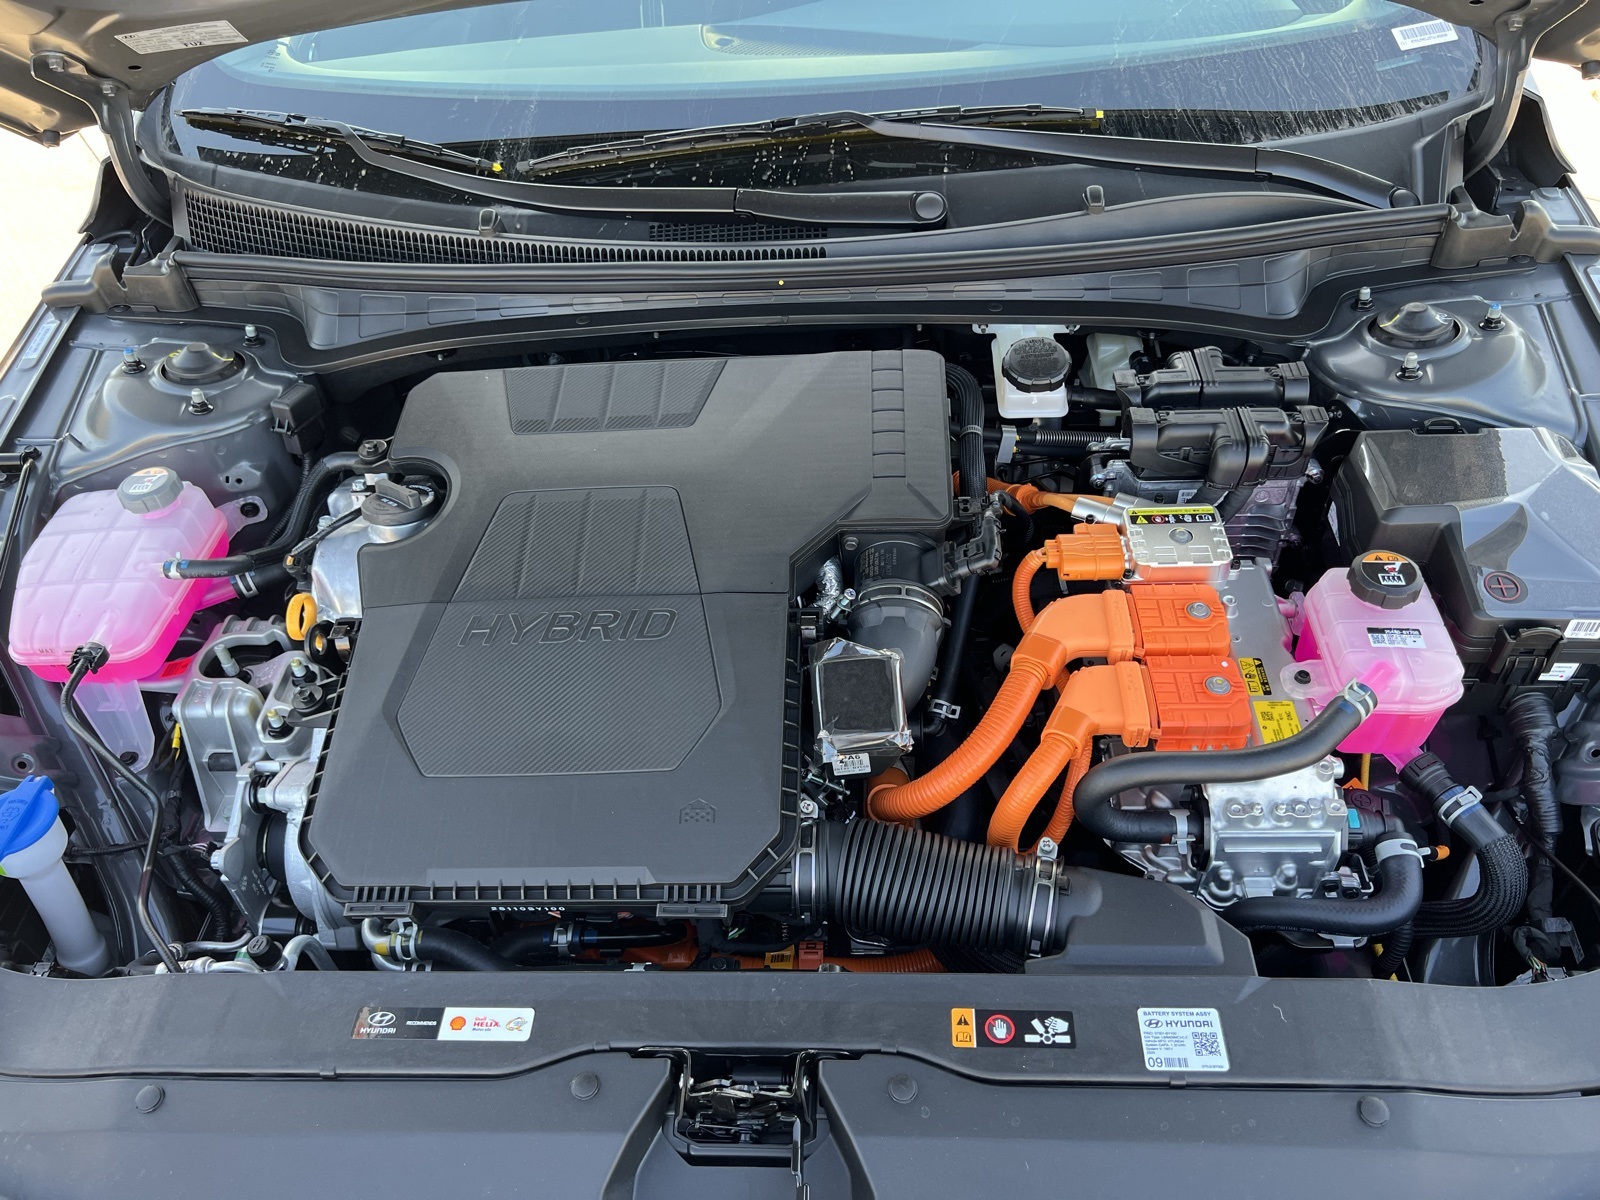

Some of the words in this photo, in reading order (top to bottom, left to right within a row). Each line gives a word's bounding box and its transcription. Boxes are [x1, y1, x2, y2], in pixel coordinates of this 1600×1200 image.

[457, 607, 678, 648] HYBRID
[1165, 1020, 1214, 1028] HYUNDAI
[359, 1027, 397, 1035] HYUNDAI
[1147, 1057, 1164, 1068] 09
